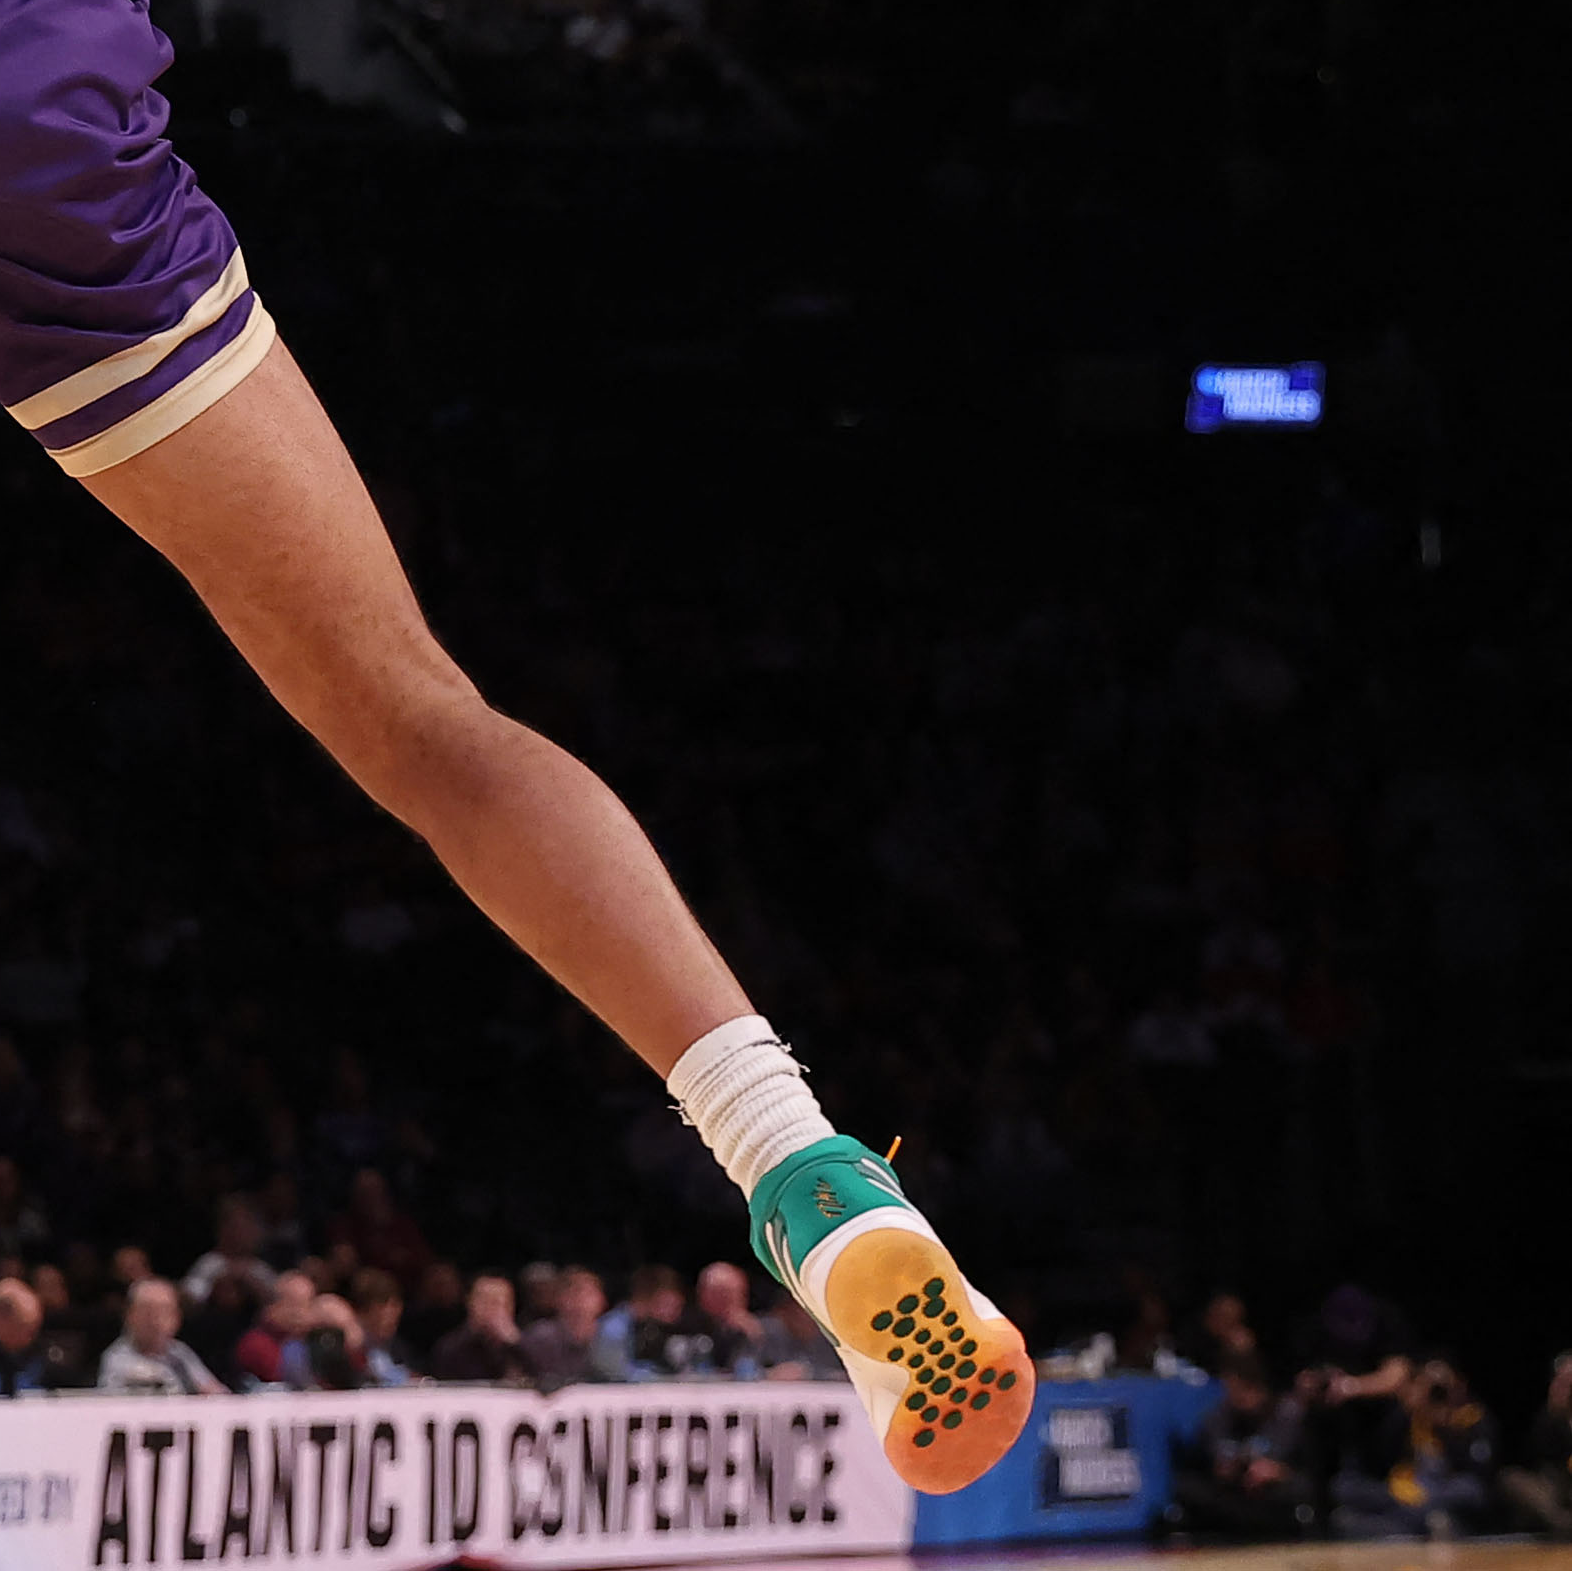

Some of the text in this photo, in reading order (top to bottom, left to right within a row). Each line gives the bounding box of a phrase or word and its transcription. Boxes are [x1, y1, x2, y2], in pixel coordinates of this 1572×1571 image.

[94, 1410, 843, 1567] ATLANTIC 10 CONFERENCE
